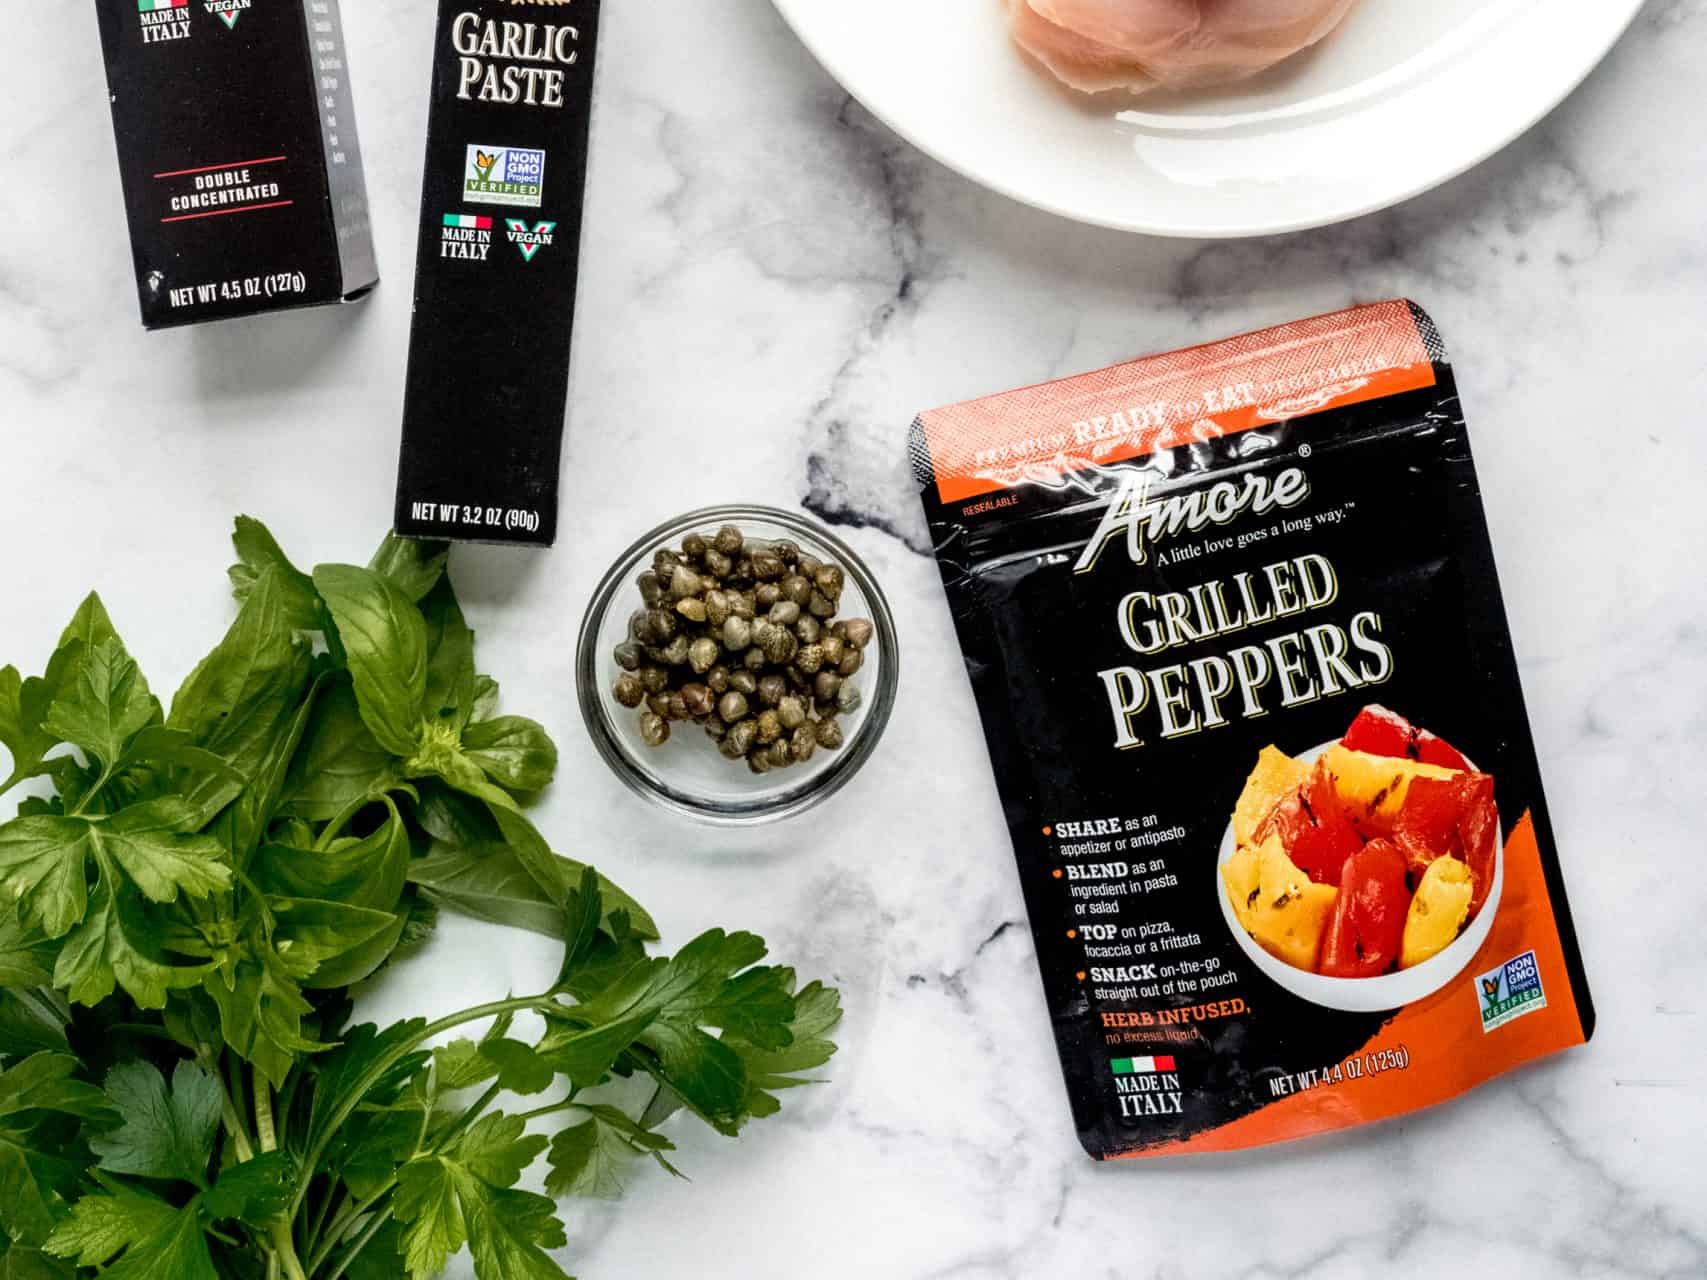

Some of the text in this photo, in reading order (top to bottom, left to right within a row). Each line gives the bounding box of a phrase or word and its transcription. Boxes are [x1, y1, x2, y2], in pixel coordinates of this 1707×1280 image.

[140, 7, 190, 26] MADE IN
[141, 20, 192, 43] ITALY
[452, 11, 579, 65] GARLIC
[456, 56, 565, 108] PASTE
[507, 162, 540, 174] GMO
[508, 151, 540, 163] NON
[195, 169, 251, 190] DOUBLE
[470, 181, 537, 194] VERIFIED
[507, 172, 538, 183] Project
[171, 183, 279, 211] CONCENTRATED
[442, 228, 491, 243] MADE IN
[506, 231, 553, 245] VEGAN
[440, 241, 491, 261] ITALY
[169, 271, 306, 308] NET WT 4.5 OZ (127g)
[1072, 401, 1166, 444] READY
[1203, 383, 1256, 413] EAT
[411, 502, 540, 532] NET WT 3.2 OZ (90g)
[962, 495, 1019, 517] RESEALABLE
[1072, 468, 1311, 575] Amore
[1157, 553, 1169, 567] A
[1170, 543, 1202, 563] little
[1204, 535, 1234, 554] love
[1237, 528, 1268, 549] goes
[1270, 525, 1280, 537] a
[1282, 517, 1313, 532] long
[1117, 553, 1339, 655] GRILLED
[1097, 611, 1394, 750] PEPPERS
[1055, 814, 1158, 839] SHARE as an
[1060, 825, 1186, 857] appetizer or antipasto
[1065, 858, 1165, 880] BLEND as an
[1070, 872, 1178, 899] ingredient in pasta
[1074, 900, 1120, 915] or salad
[1079, 920, 1175, 941] TOP on pizza,
[1084, 933, 1201, 958] focaccia or a frittata
[1090, 957, 1221, 983] SNACK on-the-go
[1507, 955, 1532, 974] NON
[1508, 967, 1535, 984] GMO
[1095, 970, 1238, 1002] straight out of the pouch
[1510, 977, 1537, 992] Project
[1486, 988, 1540, 1018] VERIFIED
[1101, 1011, 1154, 1028] HERB
[1106, 1032, 1121, 1045] no
[1269, 1046, 1410, 1097] NET WT 4.4 OZ (125g)
[1114, 1073, 1180, 1094] MADE IN
[1118, 1091, 1184, 1117] ITALY
